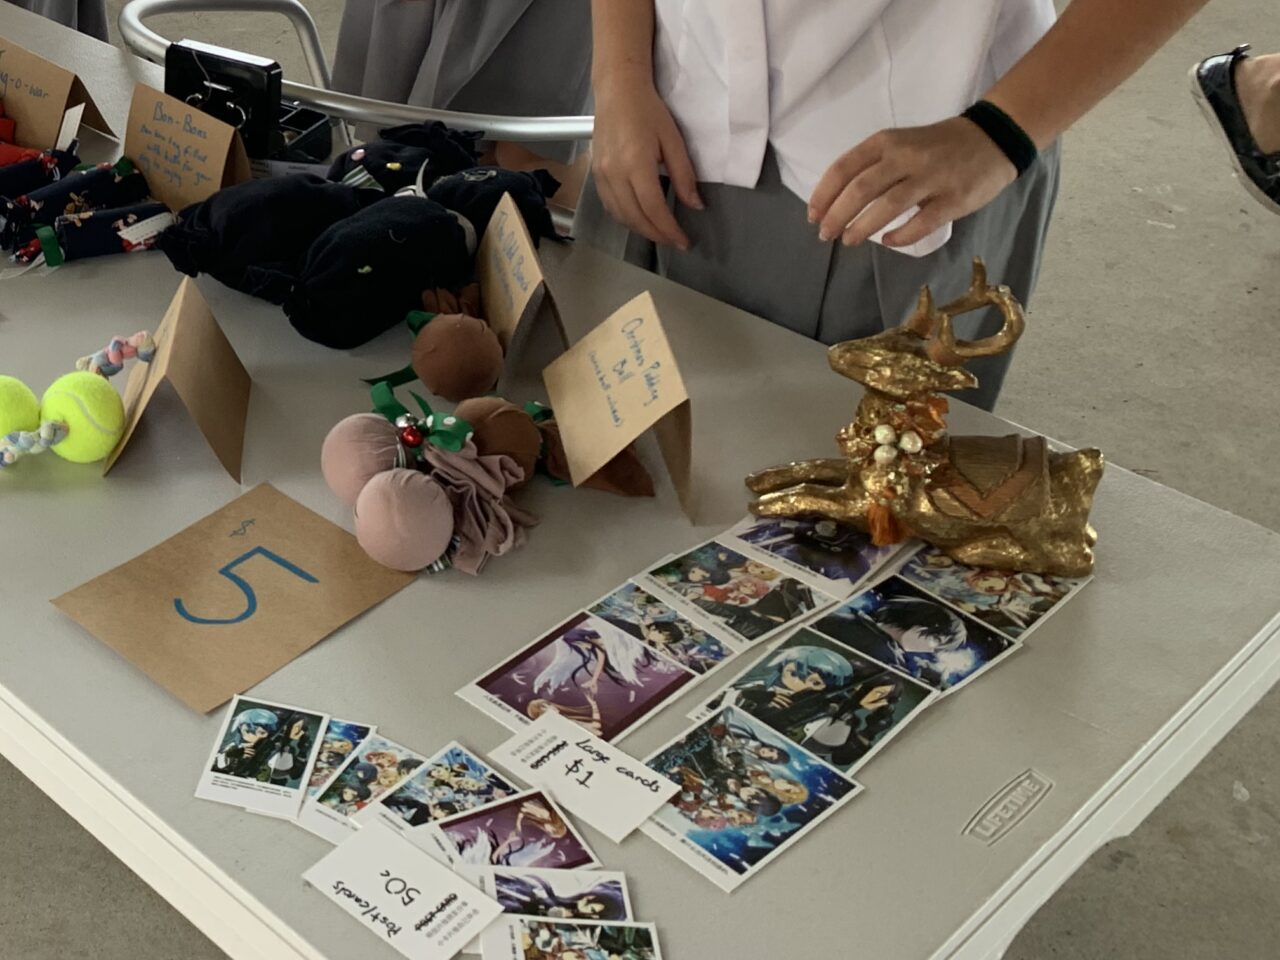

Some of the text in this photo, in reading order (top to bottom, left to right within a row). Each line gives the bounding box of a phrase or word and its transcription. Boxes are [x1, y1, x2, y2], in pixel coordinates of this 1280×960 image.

[565, 758, 595, 789] $1
[575, 738, 612, 764] Large
[616, 766, 662, 793] cards
[974, 779, 1043, 838] LIFETIME
[379, 869, 422, 907] 50c
